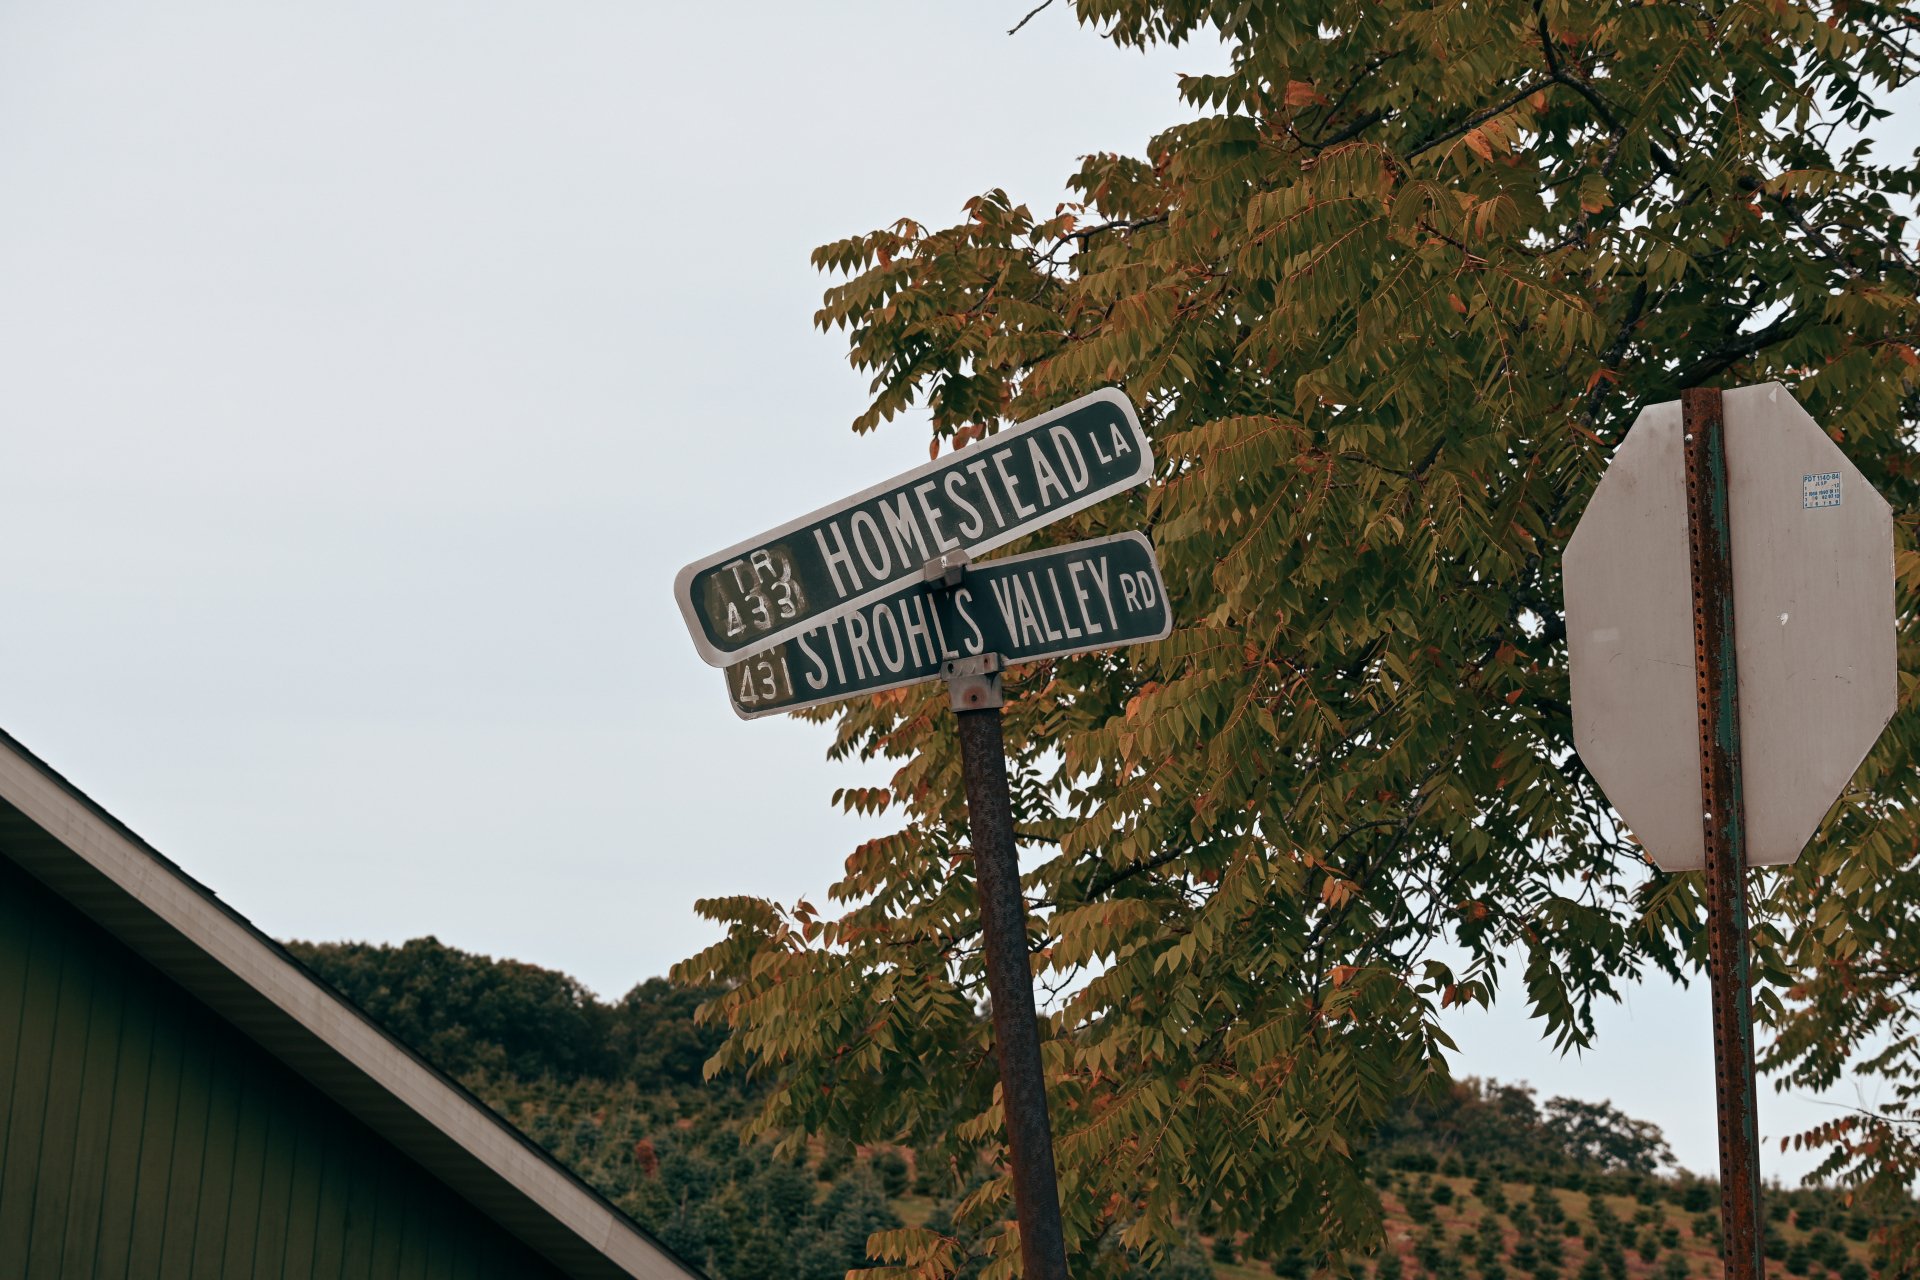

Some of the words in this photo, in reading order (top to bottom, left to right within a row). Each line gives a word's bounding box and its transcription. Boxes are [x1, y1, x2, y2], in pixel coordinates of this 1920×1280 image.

[813, 425, 1089, 598] HOMESTEAD
[1089, 422, 1132, 465] LA
[727, 580, 796, 637] 433
[796, 588, 984, 690] STROHL'S
[989, 556, 1119, 648] VALLEY
[1119, 570, 1156, 612] RD
[739, 656, 794, 704] 431
